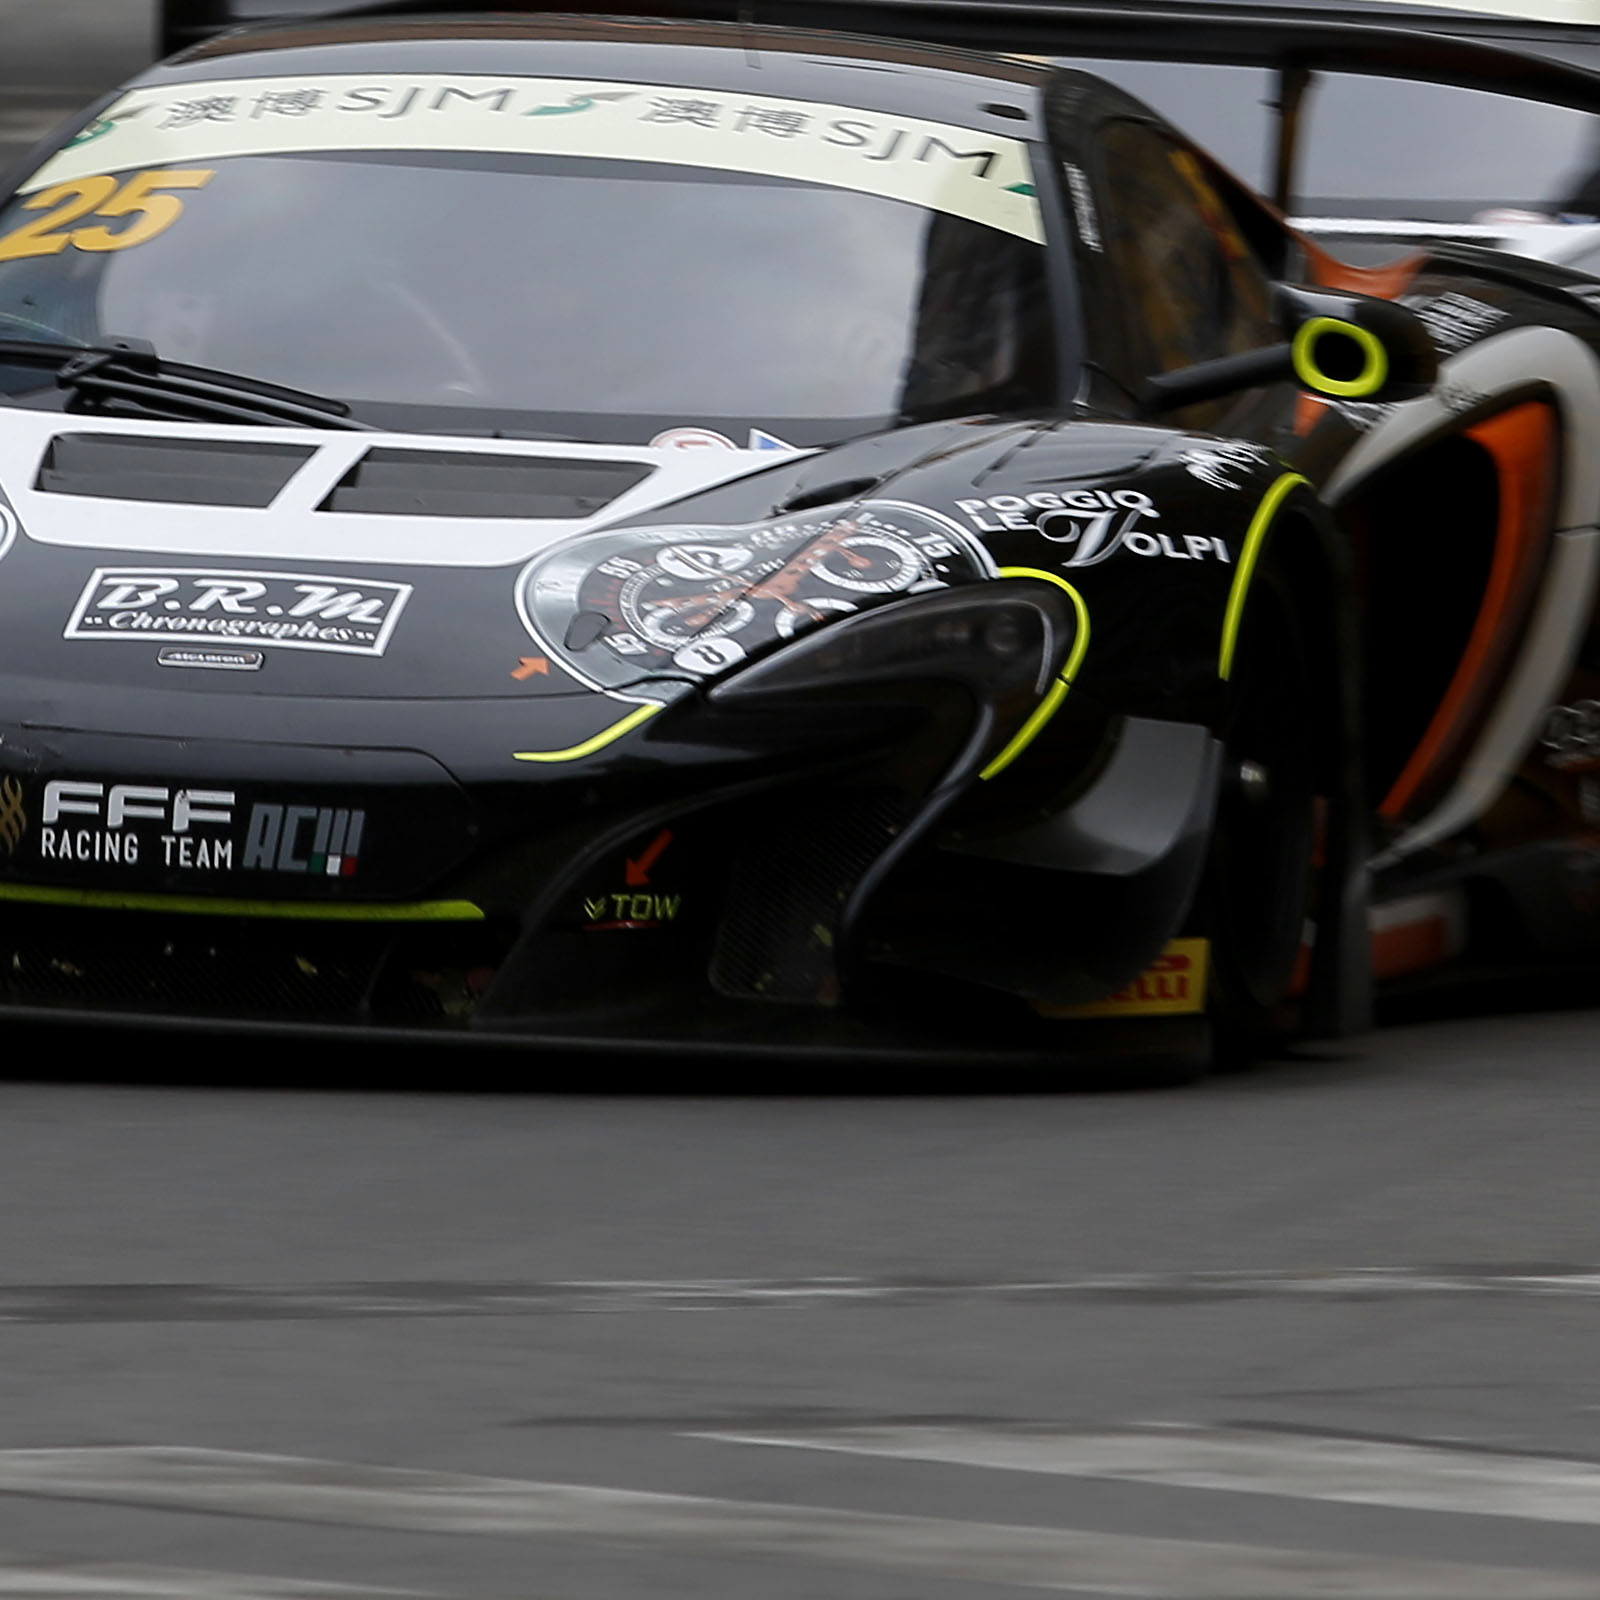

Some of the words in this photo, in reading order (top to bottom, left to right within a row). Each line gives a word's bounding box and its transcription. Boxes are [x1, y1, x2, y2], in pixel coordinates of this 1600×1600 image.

[41, 779, 236, 833] FFF
[40, 826, 140, 865] RACING
[160, 834, 234, 870] TEAM
[611, 893, 681, 920] TOW
